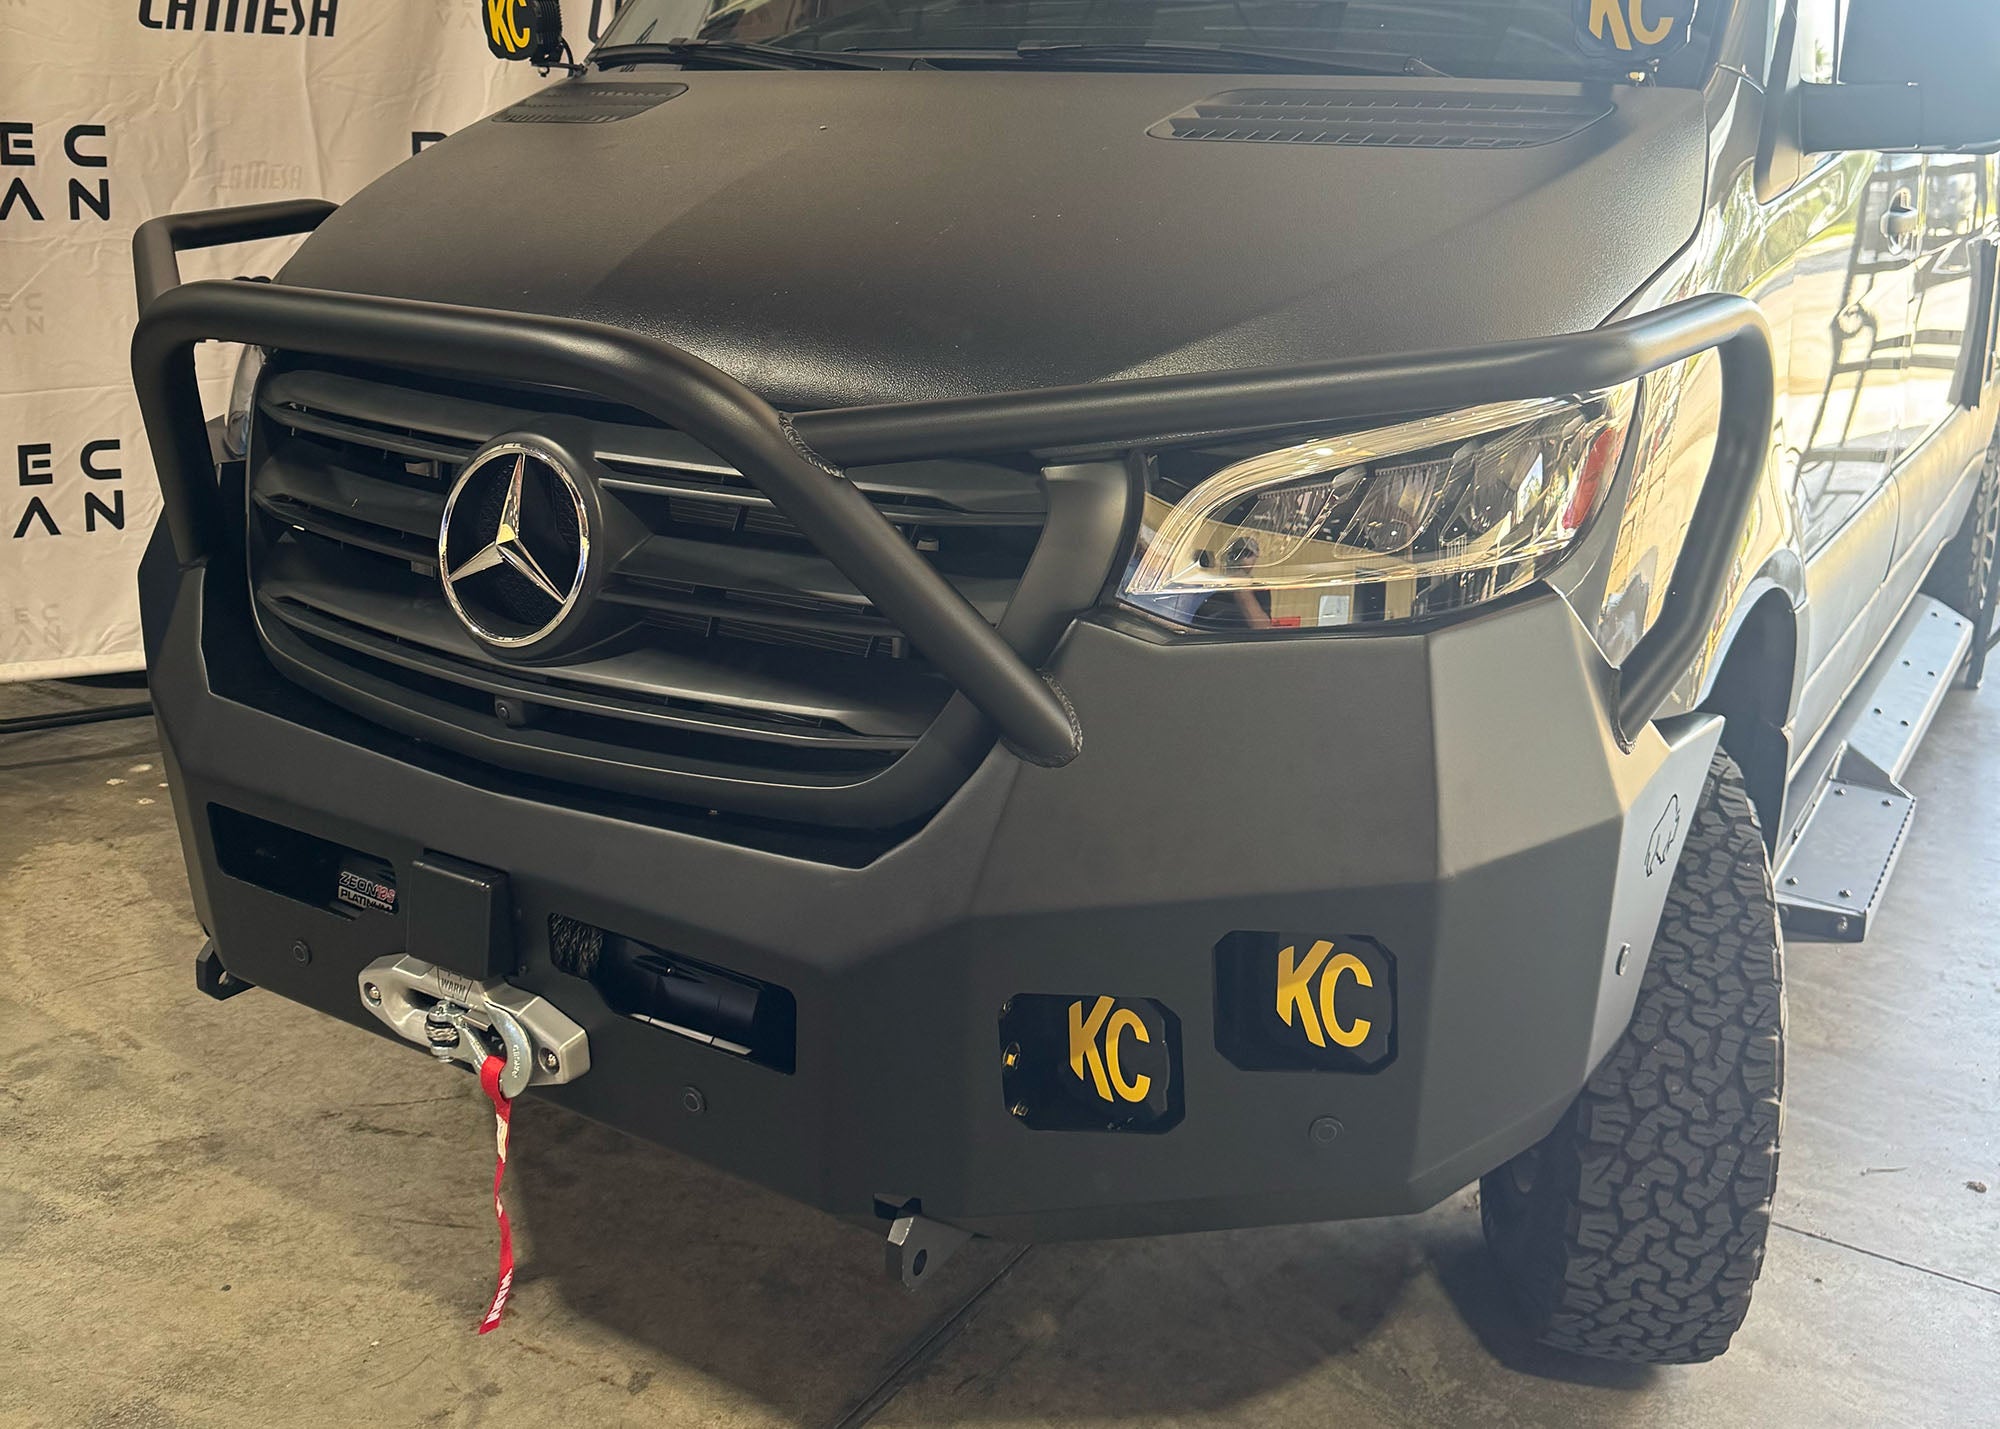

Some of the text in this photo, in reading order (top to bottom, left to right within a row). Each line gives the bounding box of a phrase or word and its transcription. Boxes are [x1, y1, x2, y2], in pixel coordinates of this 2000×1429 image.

[487, 0, 531, 53] KC
[441, 977, 467, 995] WARN
[1276, 940, 1373, 1048] KC
[1068, 996, 1151, 1103] KC
